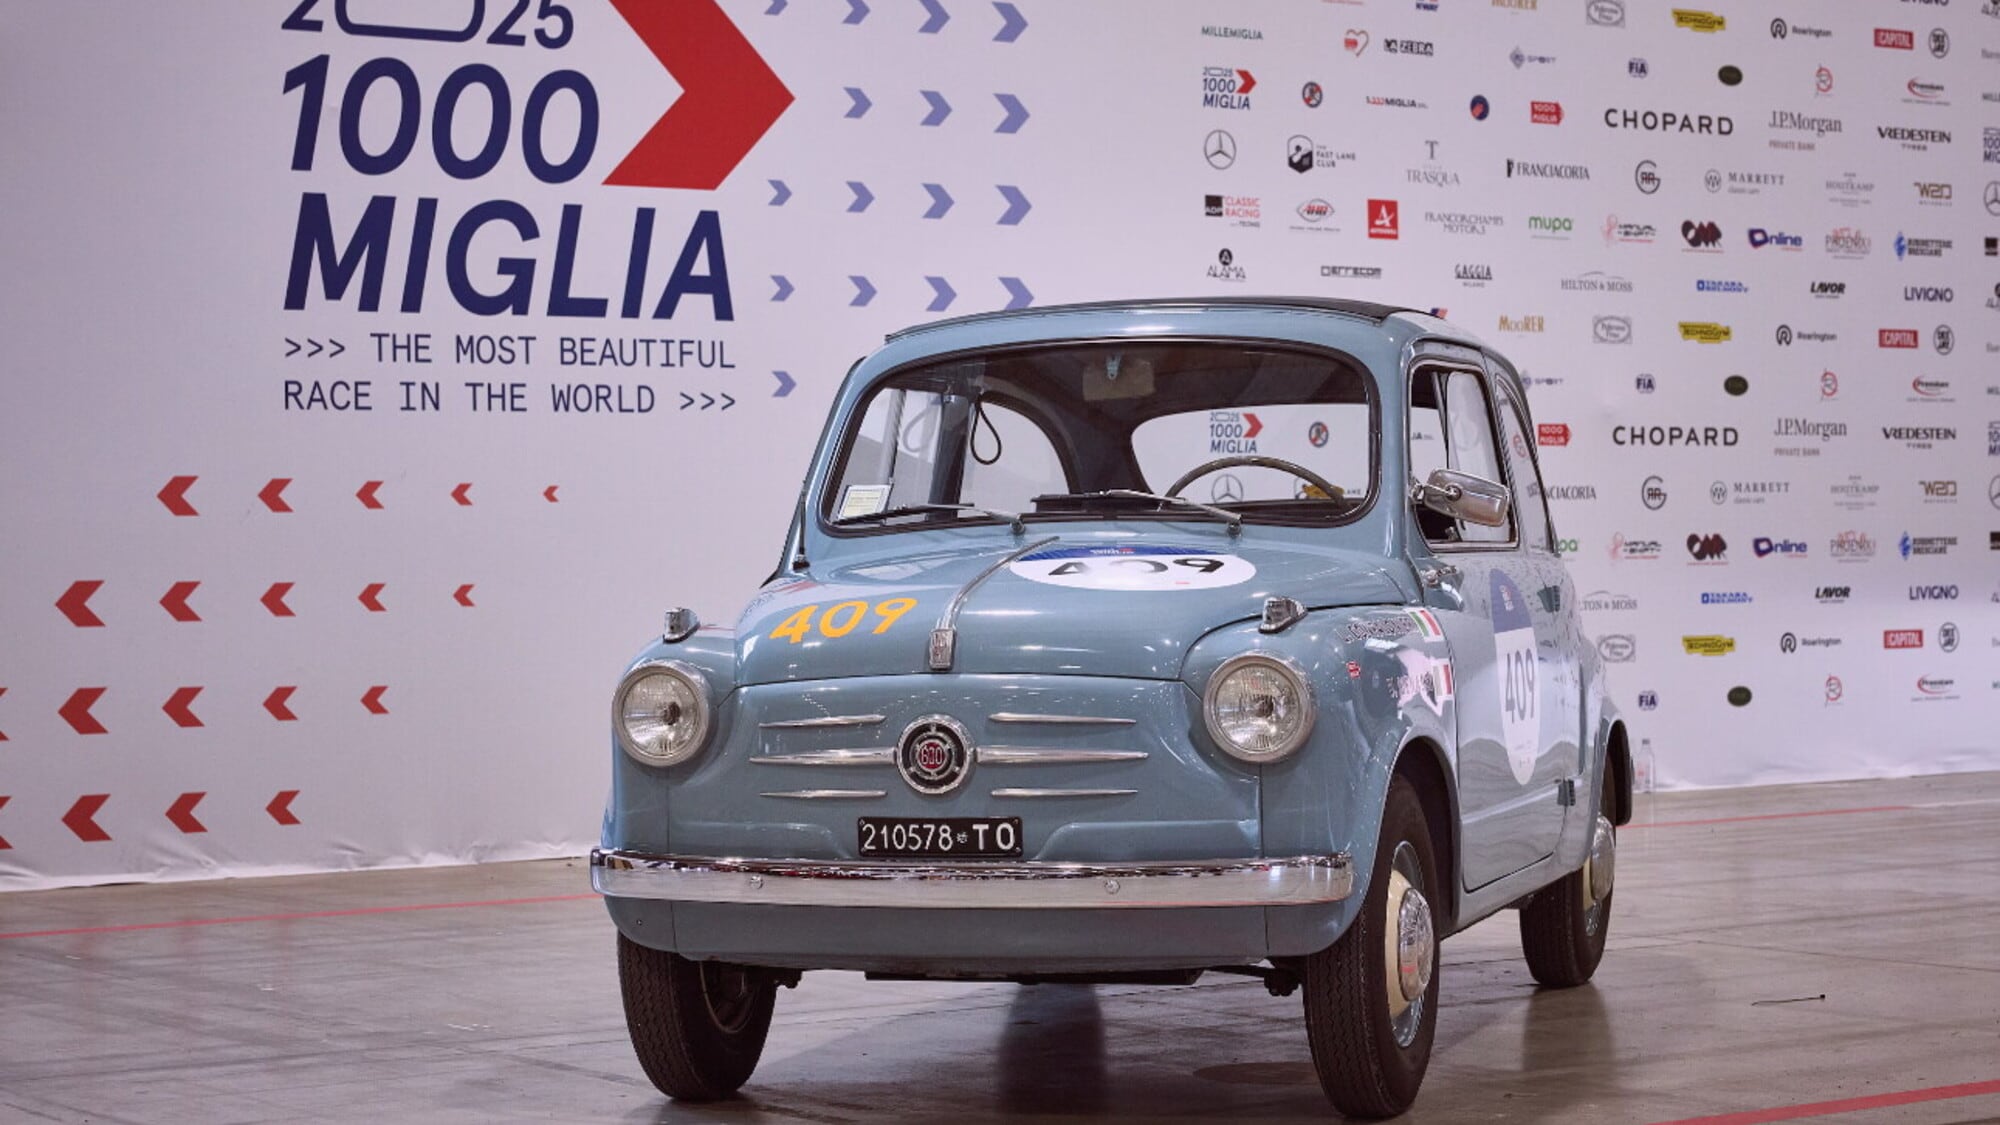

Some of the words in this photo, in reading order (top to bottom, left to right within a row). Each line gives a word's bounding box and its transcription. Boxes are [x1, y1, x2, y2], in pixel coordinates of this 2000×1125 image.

[1202, 26, 1263, 40] MILLEMIGLIA
[1792, 26, 1832, 38] Roarington
[1879, 31, 1911, 47] CAPITAL
[1202, 78, 1236, 93] 1000
[1202, 93, 1251, 110] MIGLIA
[282, 54, 599, 184] 1000
[1605, 108, 1733, 136] CHOPARD
[1768, 111, 1843, 137] J.P.Morgan
[1877, 126, 1951, 144] VREDESTEIN
[1316, 150, 1333, 160] FAST
[1336, 152, 1356, 162] LANE
[1316, 159, 1336, 168] CLUB
[1406, 168, 1460, 187] TRASQUA
[1517, 162, 1590, 180] FRANCIACORTA
[1224, 196, 1261, 208] CLASSIC
[1225, 207, 1261, 219] RACING
[1443, 223, 1486, 235] MOTORS
[1528, 215, 1573, 233] mupa
[283, 192, 735, 322] MIGLIA
[1455, 263, 1493, 280] GAGGIA
[1561, 279, 1597, 291] HILTON
[1607, 282, 1633, 293] MOSS
[1811, 282, 1846, 294] LAVOR
[1904, 286, 1954, 302] LIVIGNO
[1797, 331, 1837, 342] Roarington
[1884, 331, 1916, 347] CAPITAL
[370, 333, 432, 363] THE
[455, 335, 536, 365] MOST
[559, 337, 736, 368] BEAUTIFUL
[284, 381, 372, 411] RACE
[399, 381, 440, 411] IN
[465, 383, 528, 412] THE
[551, 383, 655, 413] WORLD
[1210, 424, 1243, 438] 1000
[1612, 425, 1739, 447] CHOPARD
[1774, 418, 1847, 441] J.P.Morgan
[1882, 427, 1957, 440] VREDESTEIN
[1210, 440, 1257, 453] MIGLIA
[1815, 586, 1851, 599] LAVOR
[1909, 585, 1958, 600] LIVIGNO
[1612, 599, 1638, 610] MOSS
[769, 597, 918, 643] 409
[1801, 637, 1842, 648] Roarington
[1888, 631, 1922, 647] CAPITAL
[1505, 648, 1535, 724] 409
